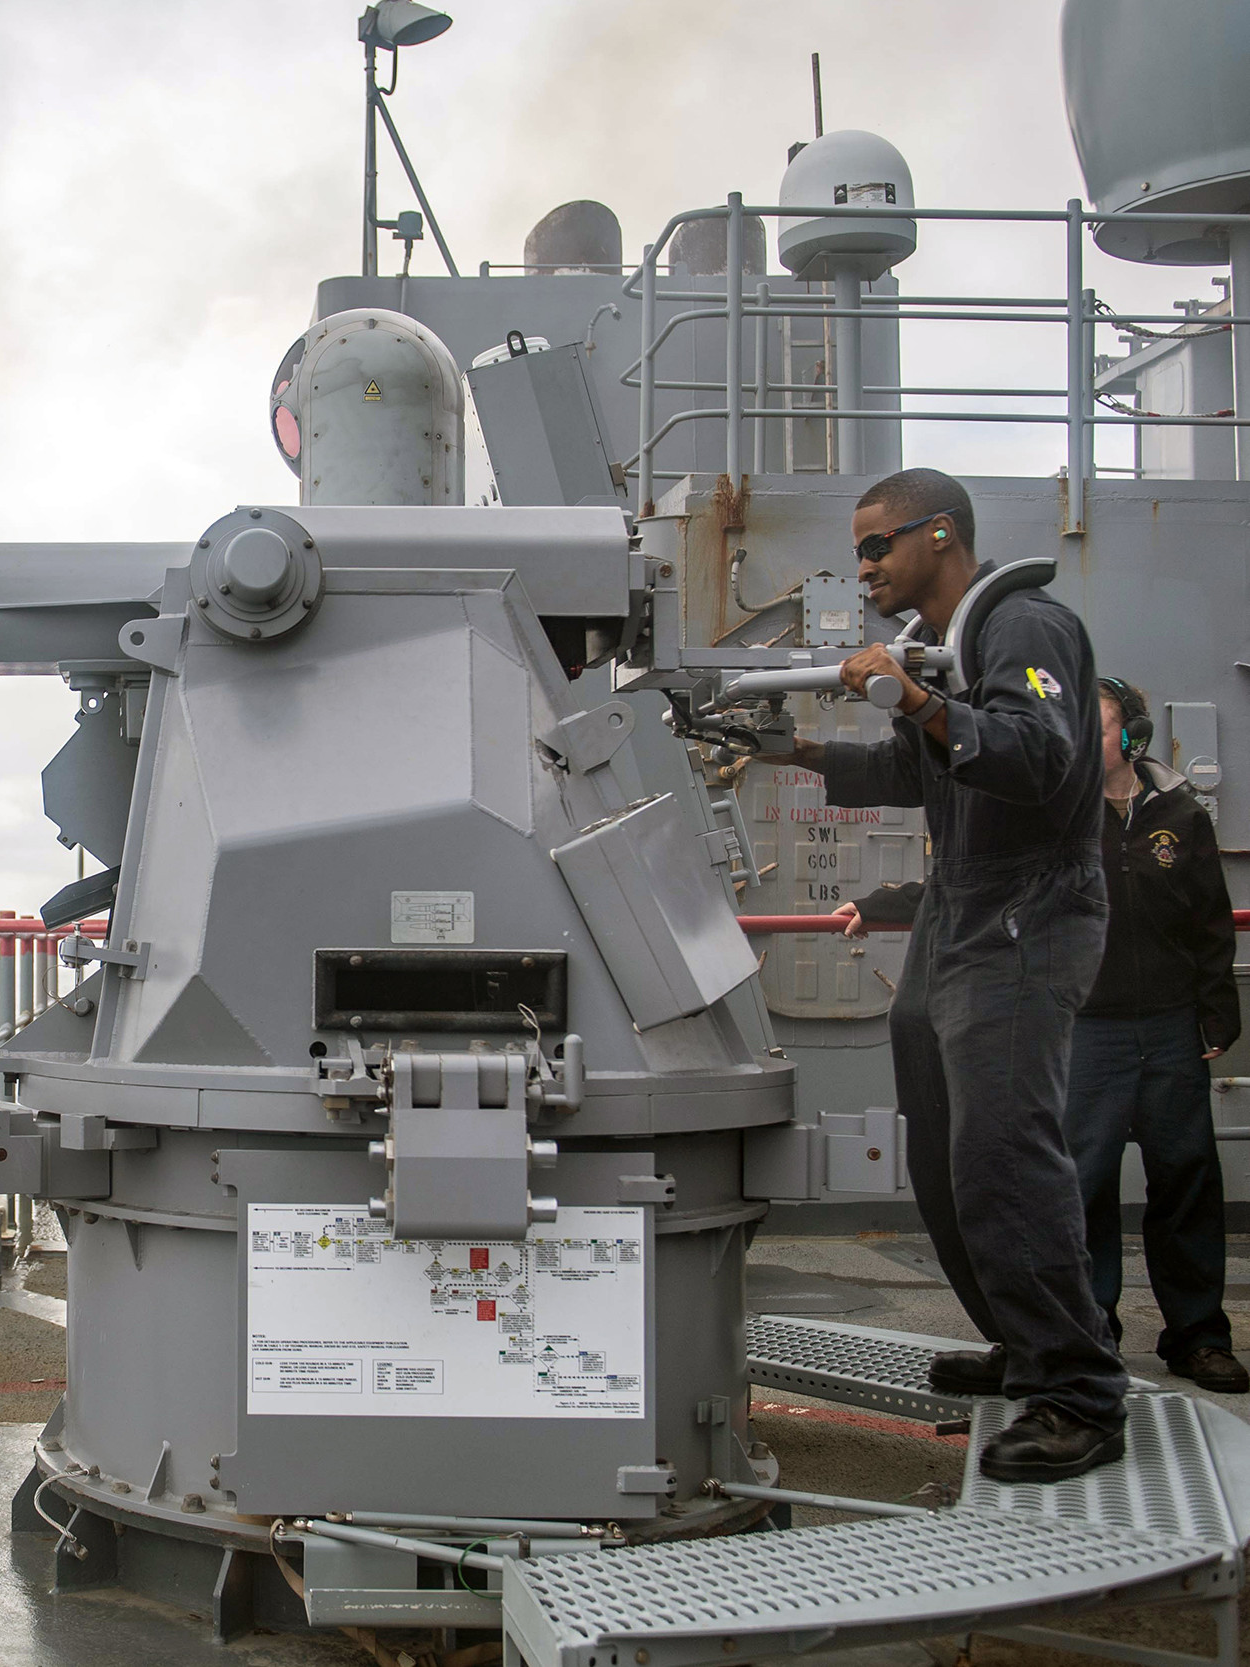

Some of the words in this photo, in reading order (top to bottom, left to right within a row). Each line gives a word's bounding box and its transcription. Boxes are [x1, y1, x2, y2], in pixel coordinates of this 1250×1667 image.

[773, 771, 823, 787] ELEVA
[765, 805, 781, 820] IN
[790, 807, 880, 824] OPERATION
[808, 827, 842, 843] SWL
[808, 883, 840, 901] LBS
